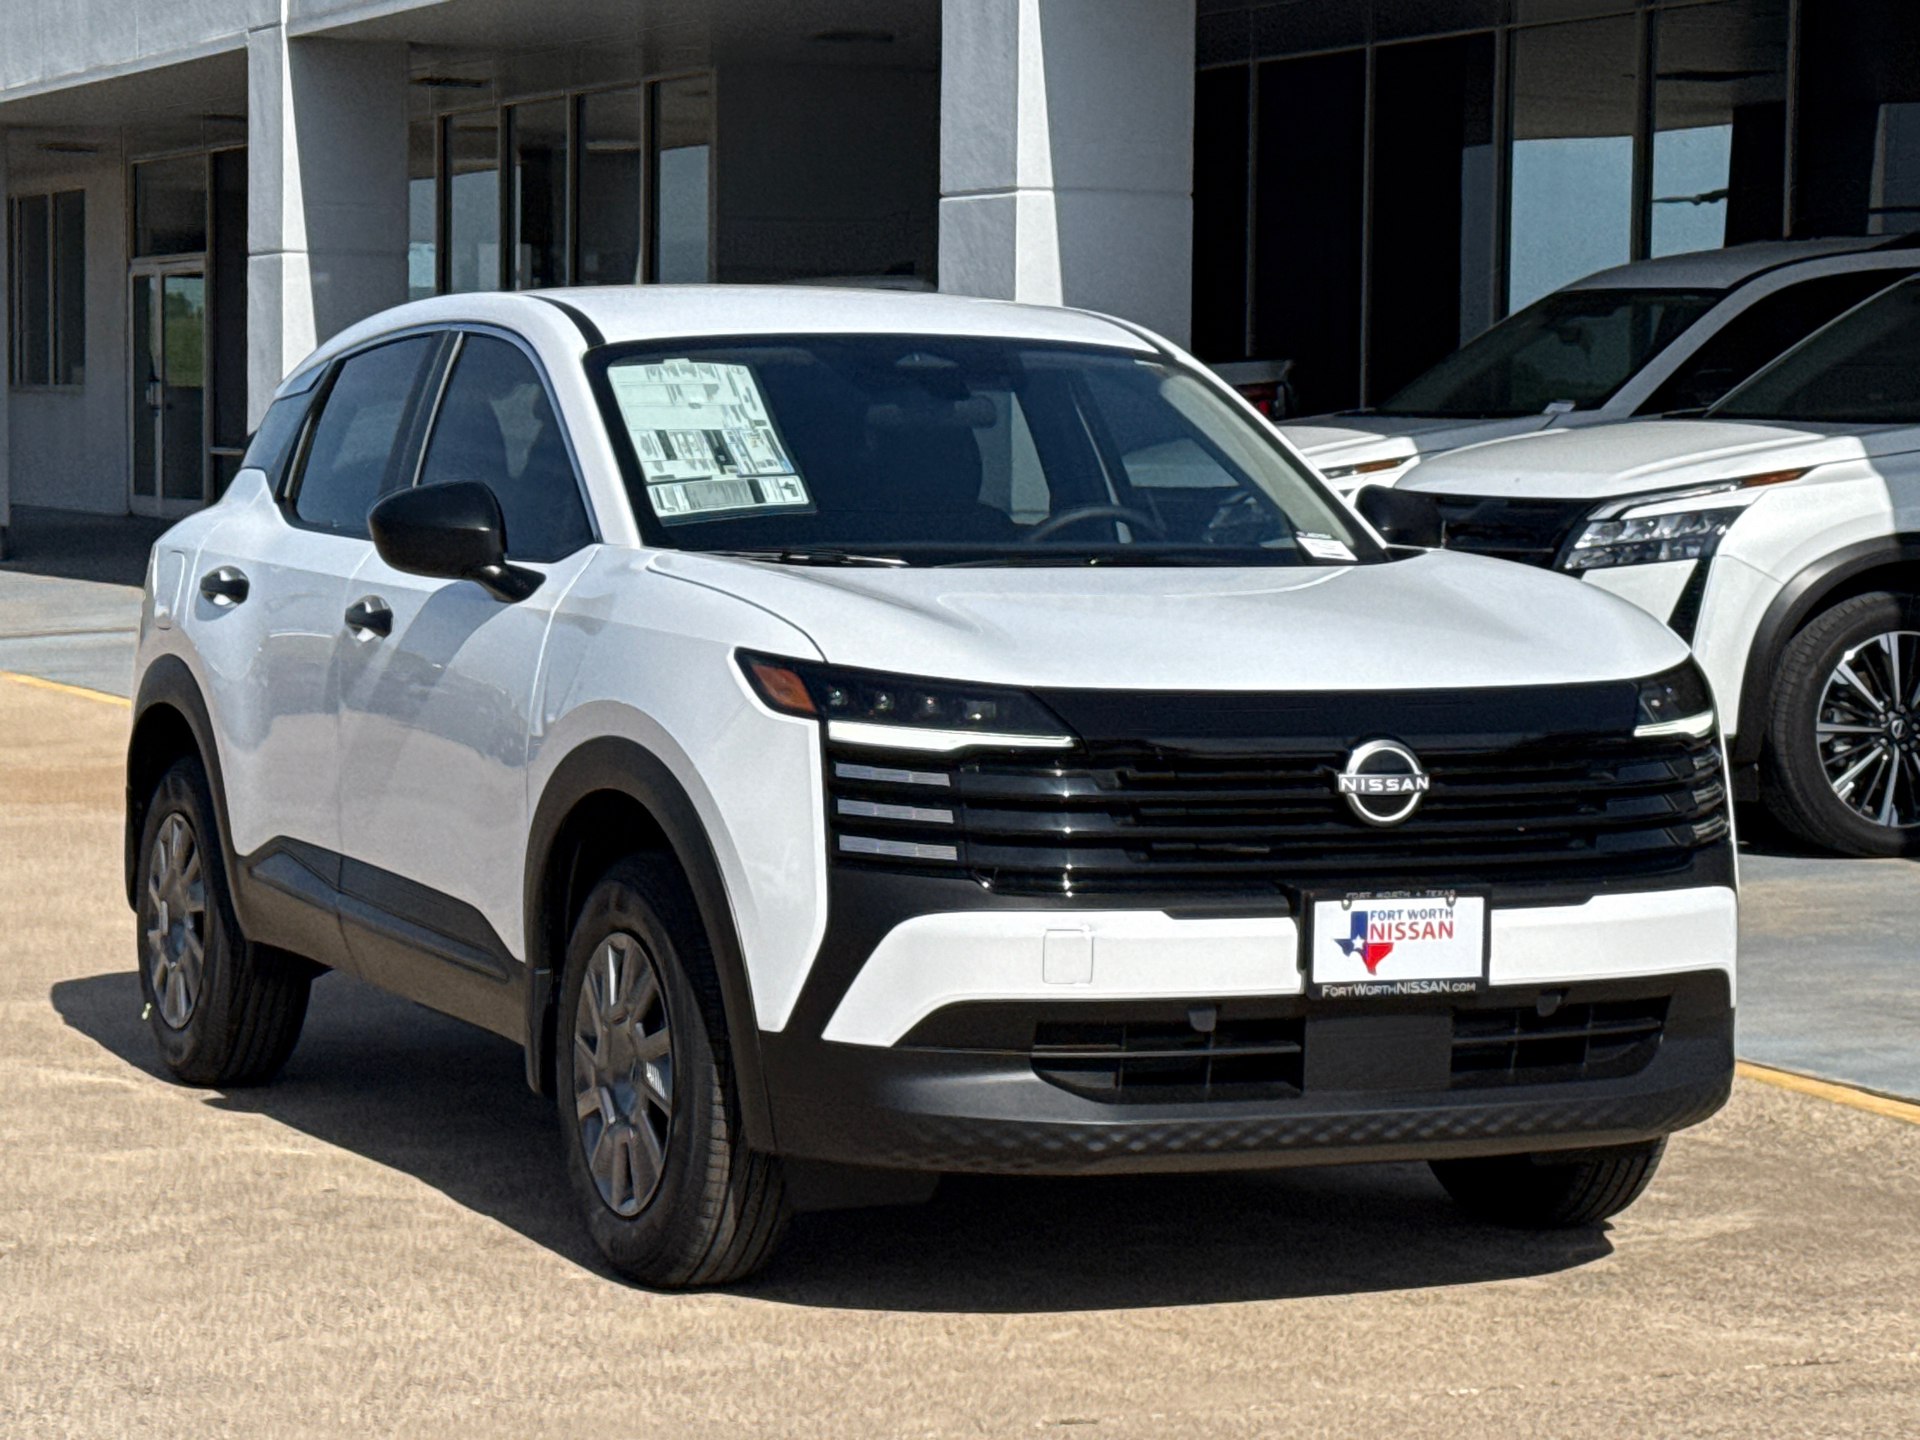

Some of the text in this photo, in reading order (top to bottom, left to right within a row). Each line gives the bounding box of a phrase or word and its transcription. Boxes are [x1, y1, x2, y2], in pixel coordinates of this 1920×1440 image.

[1341, 776, 1429, 792] NISSAN
[1370, 908, 1454, 921] FORT WORTH
[1370, 920, 1454, 941] NISSAN
